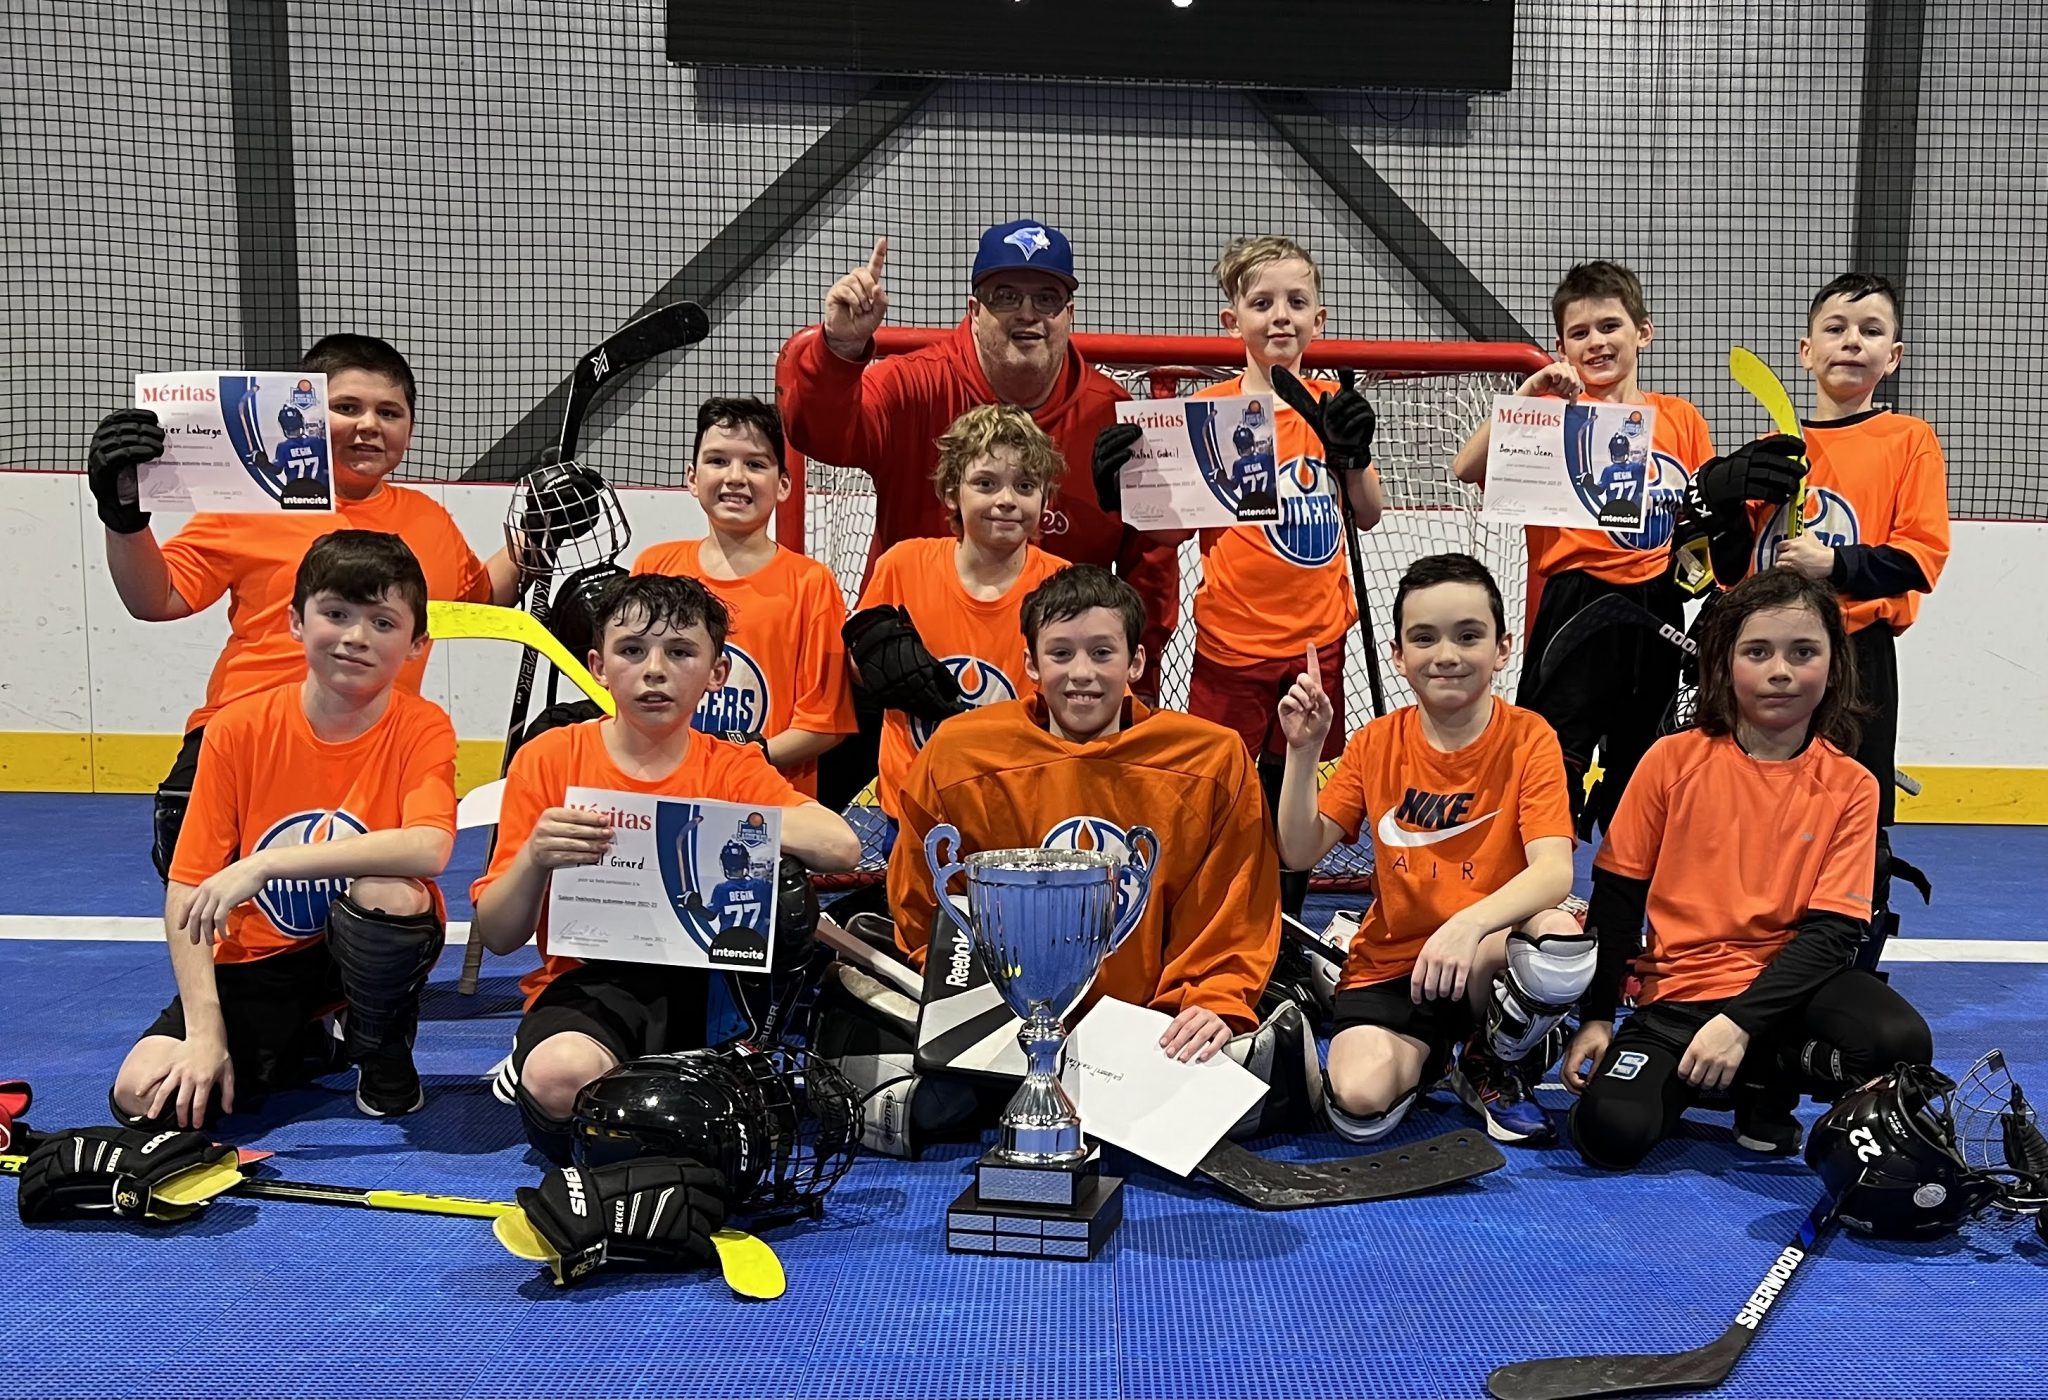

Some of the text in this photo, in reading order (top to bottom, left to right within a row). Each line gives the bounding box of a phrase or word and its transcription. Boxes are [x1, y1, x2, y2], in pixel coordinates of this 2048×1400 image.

[142, 384, 217, 403] Méritas
[1498, 407, 1561, 427] Méritas
[186, 423, 222, 439] Laberge
[1499, 443, 1554, 457] Benjamin Jean
[287, 456, 319, 479] 77
[1242, 471, 1269, 493] 77
[1609, 480, 1637, 501] 77
[1396, 787, 1475, 829] NIKE
[610, 856, 645, 870] Girard
[1393, 855, 1474, 880] AIR
[724, 902, 761, 929] 77
[712, 942, 764, 960] intencité
[946, 928, 971, 987] Reebok
[737, 1122, 749, 1172] CCM
[1849, 1126, 1883, 1163] 22
[560, 1166, 587, 1218] SHE
[614, 1199, 625, 1234] REKKER
[1734, 1245, 1805, 1330] SHERWOOD
